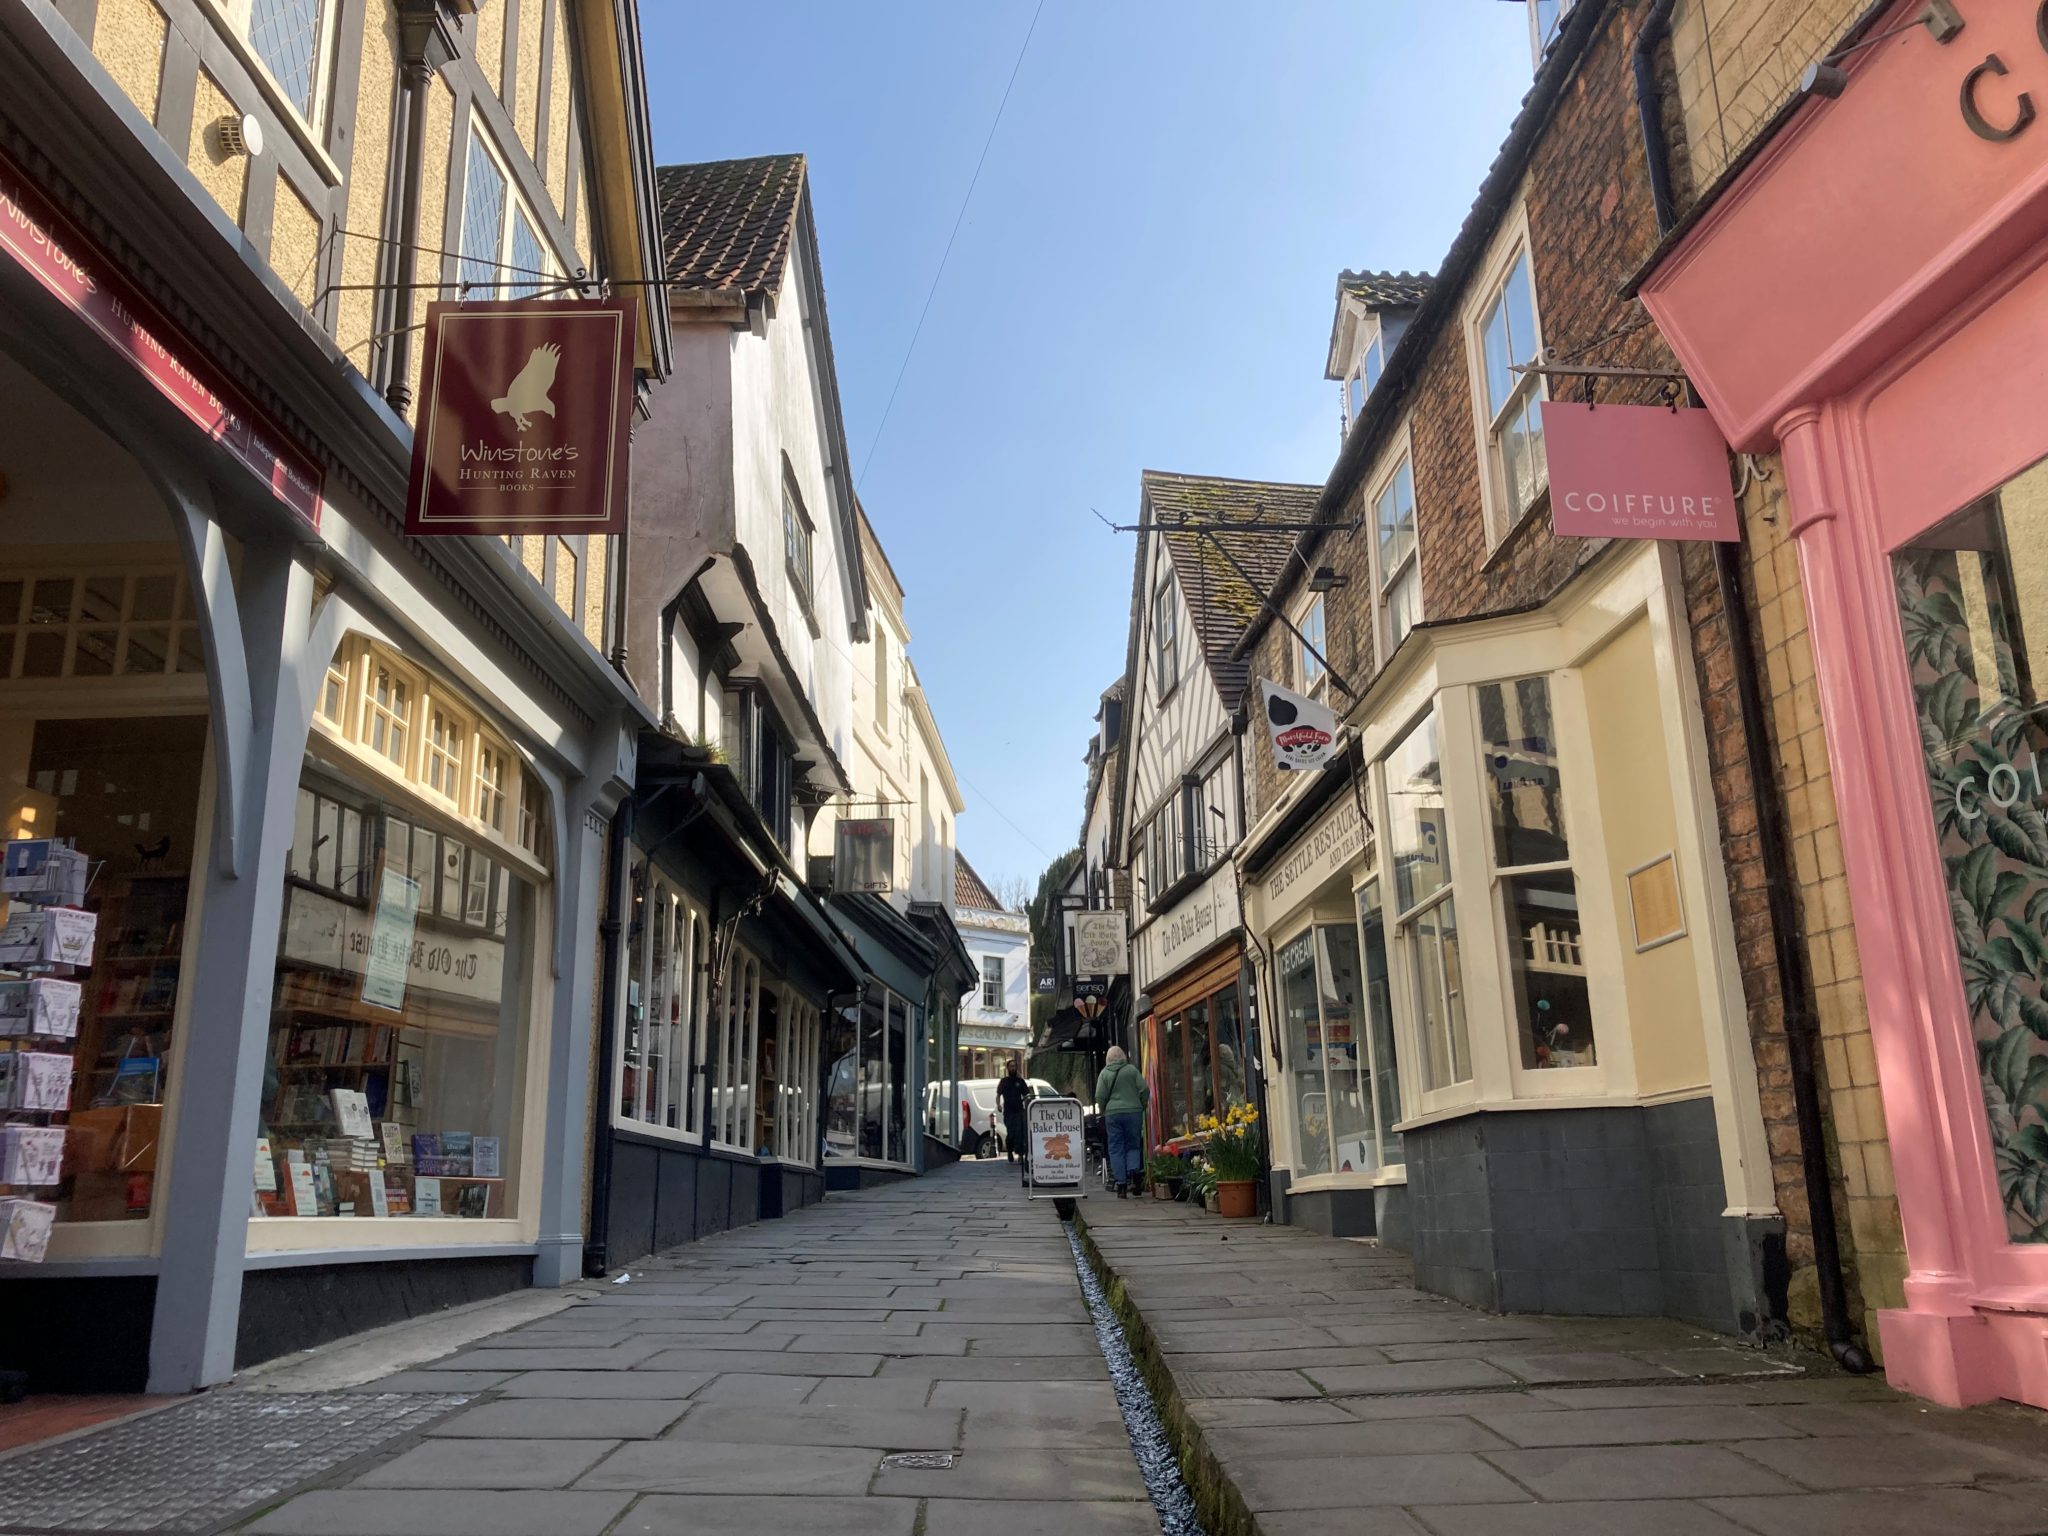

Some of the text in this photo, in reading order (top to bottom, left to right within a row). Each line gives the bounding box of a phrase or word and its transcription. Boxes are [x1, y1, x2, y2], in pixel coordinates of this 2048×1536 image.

[111, 298, 166, 360] HUNTING
[169, 352, 206, 398] RAVEN
[208, 392, 241, 432] BOOKS
[461, 440, 579, 463] Winstone's
[460, 467, 576, 480] HUNTING RAVEN
[500, 484, 534, 492] BOOKS
[1565, 492, 1716, 516] COIFFURE
[1611, 515, 1718, 529] we begin with you
[1329, 847, 1342, 869] AND
[1342, 837, 1355, 857] TEA
[1269, 872, 1285, 900] THE
[1284, 843, 1314, 887] SETTLE
[1171, 922, 1181, 950] Old
[1290, 934, 1315, 969] CREAM
[1039, 1109, 1073, 1120] The Old
[1033, 1122, 1080, 1133] Bake House
